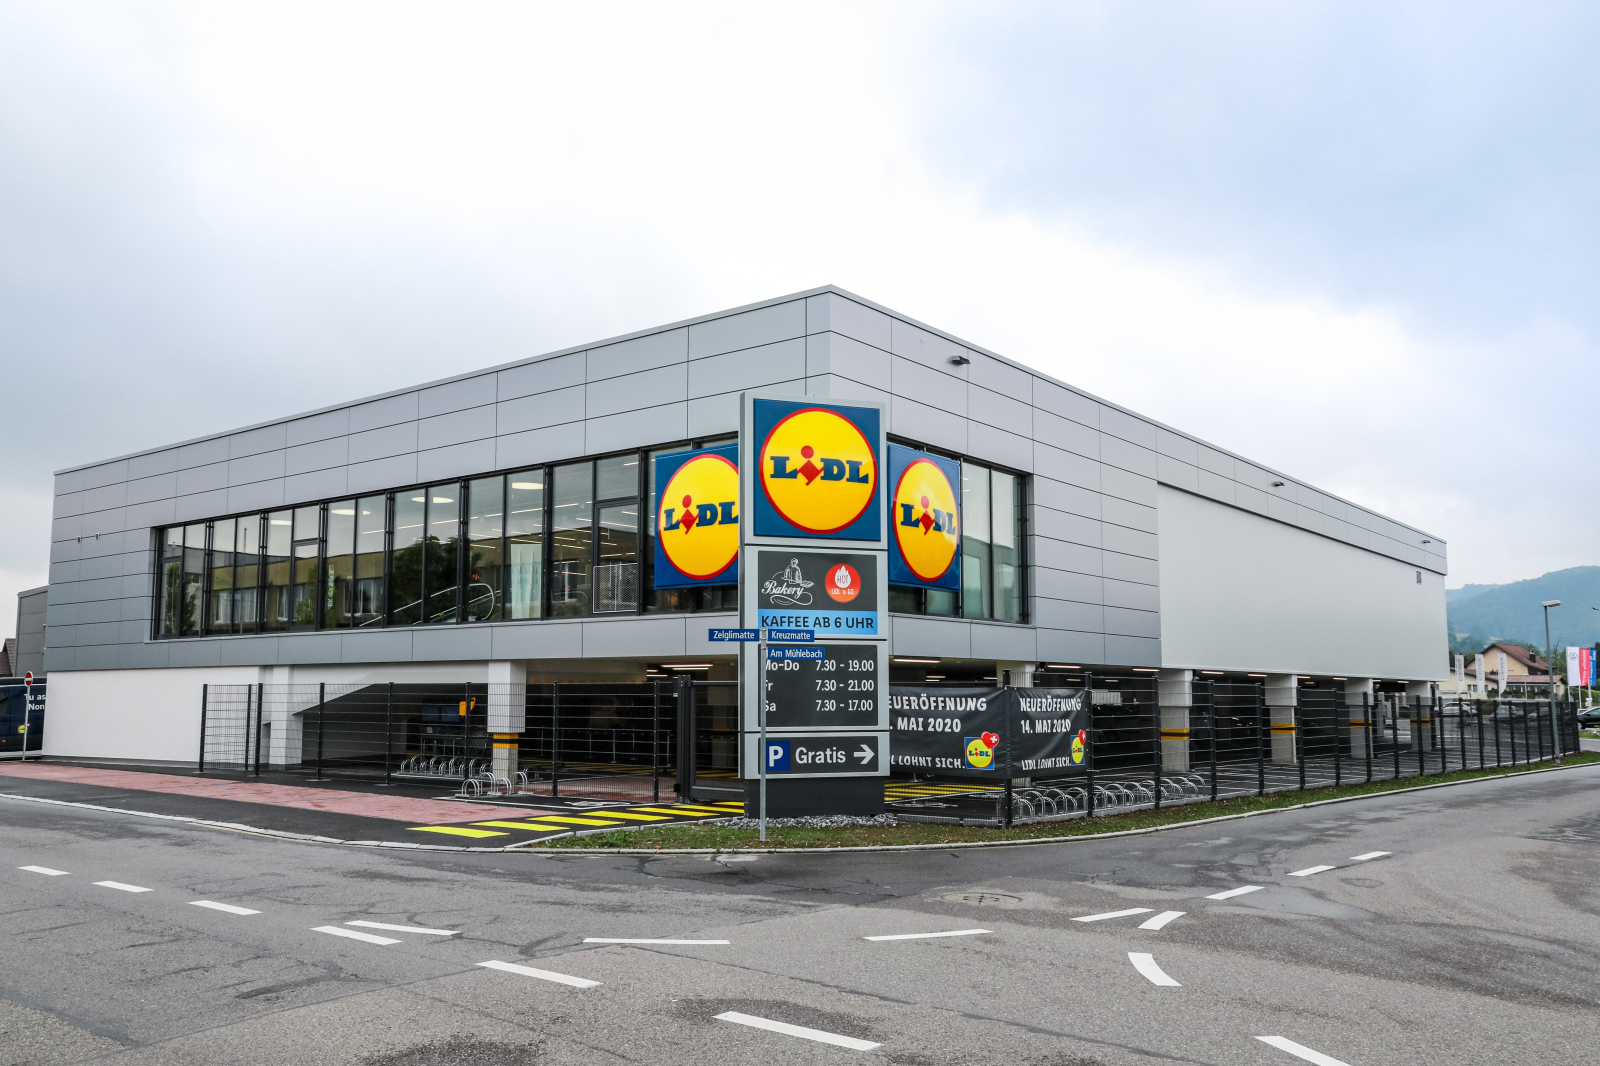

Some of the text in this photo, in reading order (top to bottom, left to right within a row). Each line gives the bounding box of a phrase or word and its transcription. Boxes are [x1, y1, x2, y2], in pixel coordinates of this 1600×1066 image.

[770, 446, 868, 486] LIDL
[900, 495, 956, 535] LIDL
[837, 575, 848, 584] HOT
[761, 580, 804, 598] Bakery
[761, 616, 874, 629] KAFFEE AB 6 UHR
[714, 631, 754, 641] Zelglimatte
[772, 631, 810, 640] Kreuzmatte
[770, 649, 822, 658] Am Mühlebach
[816, 660, 836, 671] 7.30
[848, 660, 874, 671] 19.00
[816, 680, 836, 691] 7.30
[848, 680, 874, 691] 21.00
[816, 700, 836, 711] 7.30
[848, 700, 873, 711] 17.00
[889, 694, 987, 712] EUERÖFFNUNG
[1020, 696, 1082, 711] NEUERÖFFNUNG
[897, 717, 961, 732] MAI 2020
[1021, 719, 1071, 733] 14. MAI 2020
[769, 746, 846, 767] P Gratis
[968, 748, 990, 757] LIDL
[898, 756, 932, 768] LOHNT
[936, 757, 966, 769] SICH.
[1022, 757, 1072, 770] LIDL LOHNT SICH.
